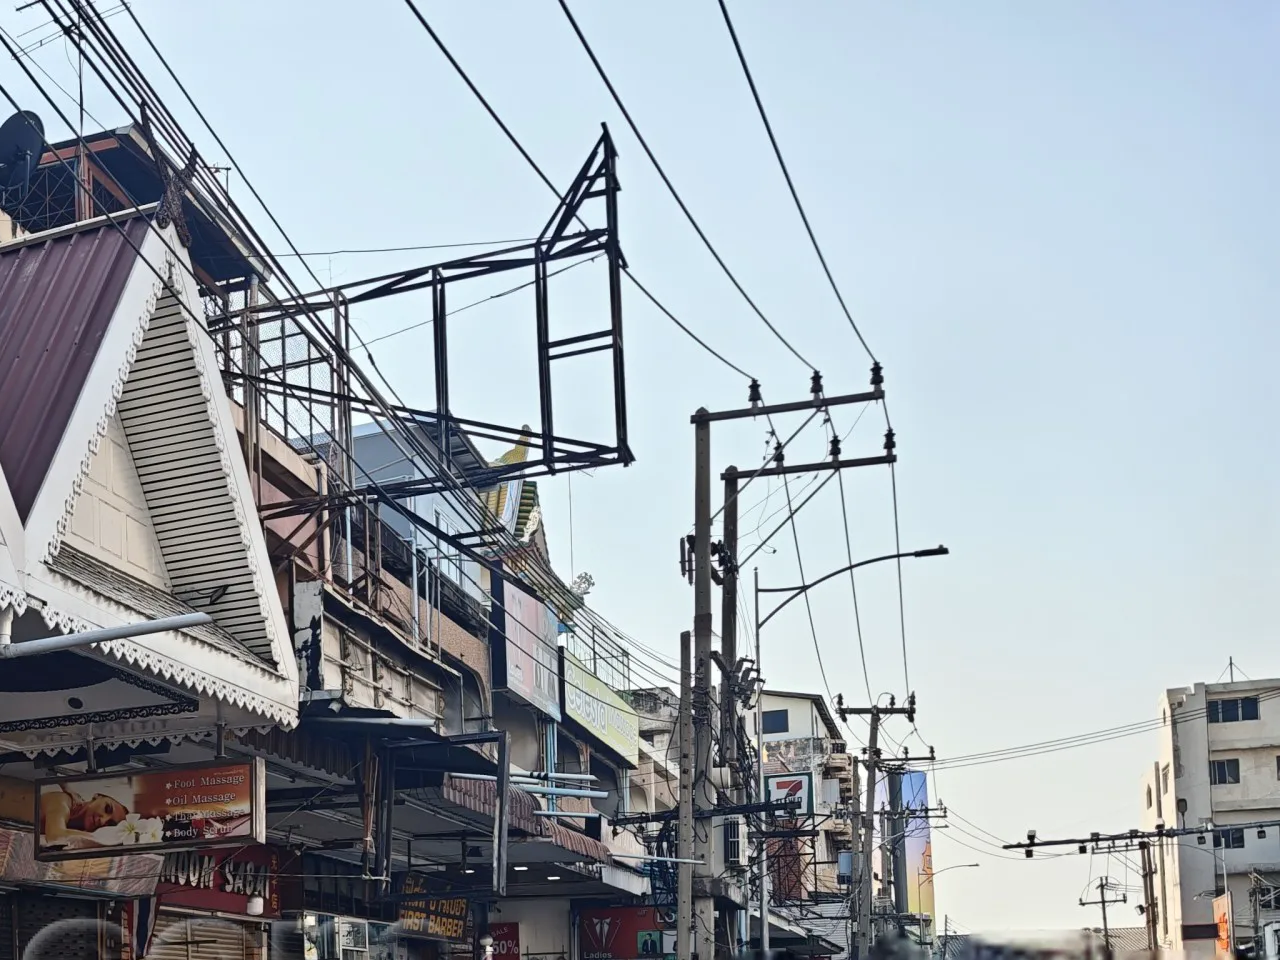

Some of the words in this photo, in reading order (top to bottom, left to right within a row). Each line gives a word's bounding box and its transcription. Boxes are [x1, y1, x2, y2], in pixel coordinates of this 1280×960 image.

[174, 779, 195, 789] Foot
[200, 775, 245, 786] Massage
[172, 794, 187, 805] Oil
[192, 792, 236, 804] Massage
[174, 827, 198, 838] Body
[203, 823, 233, 835] Scrub
[400, 910, 426, 932] FIRST
[428, 914, 464, 938] BARBER
